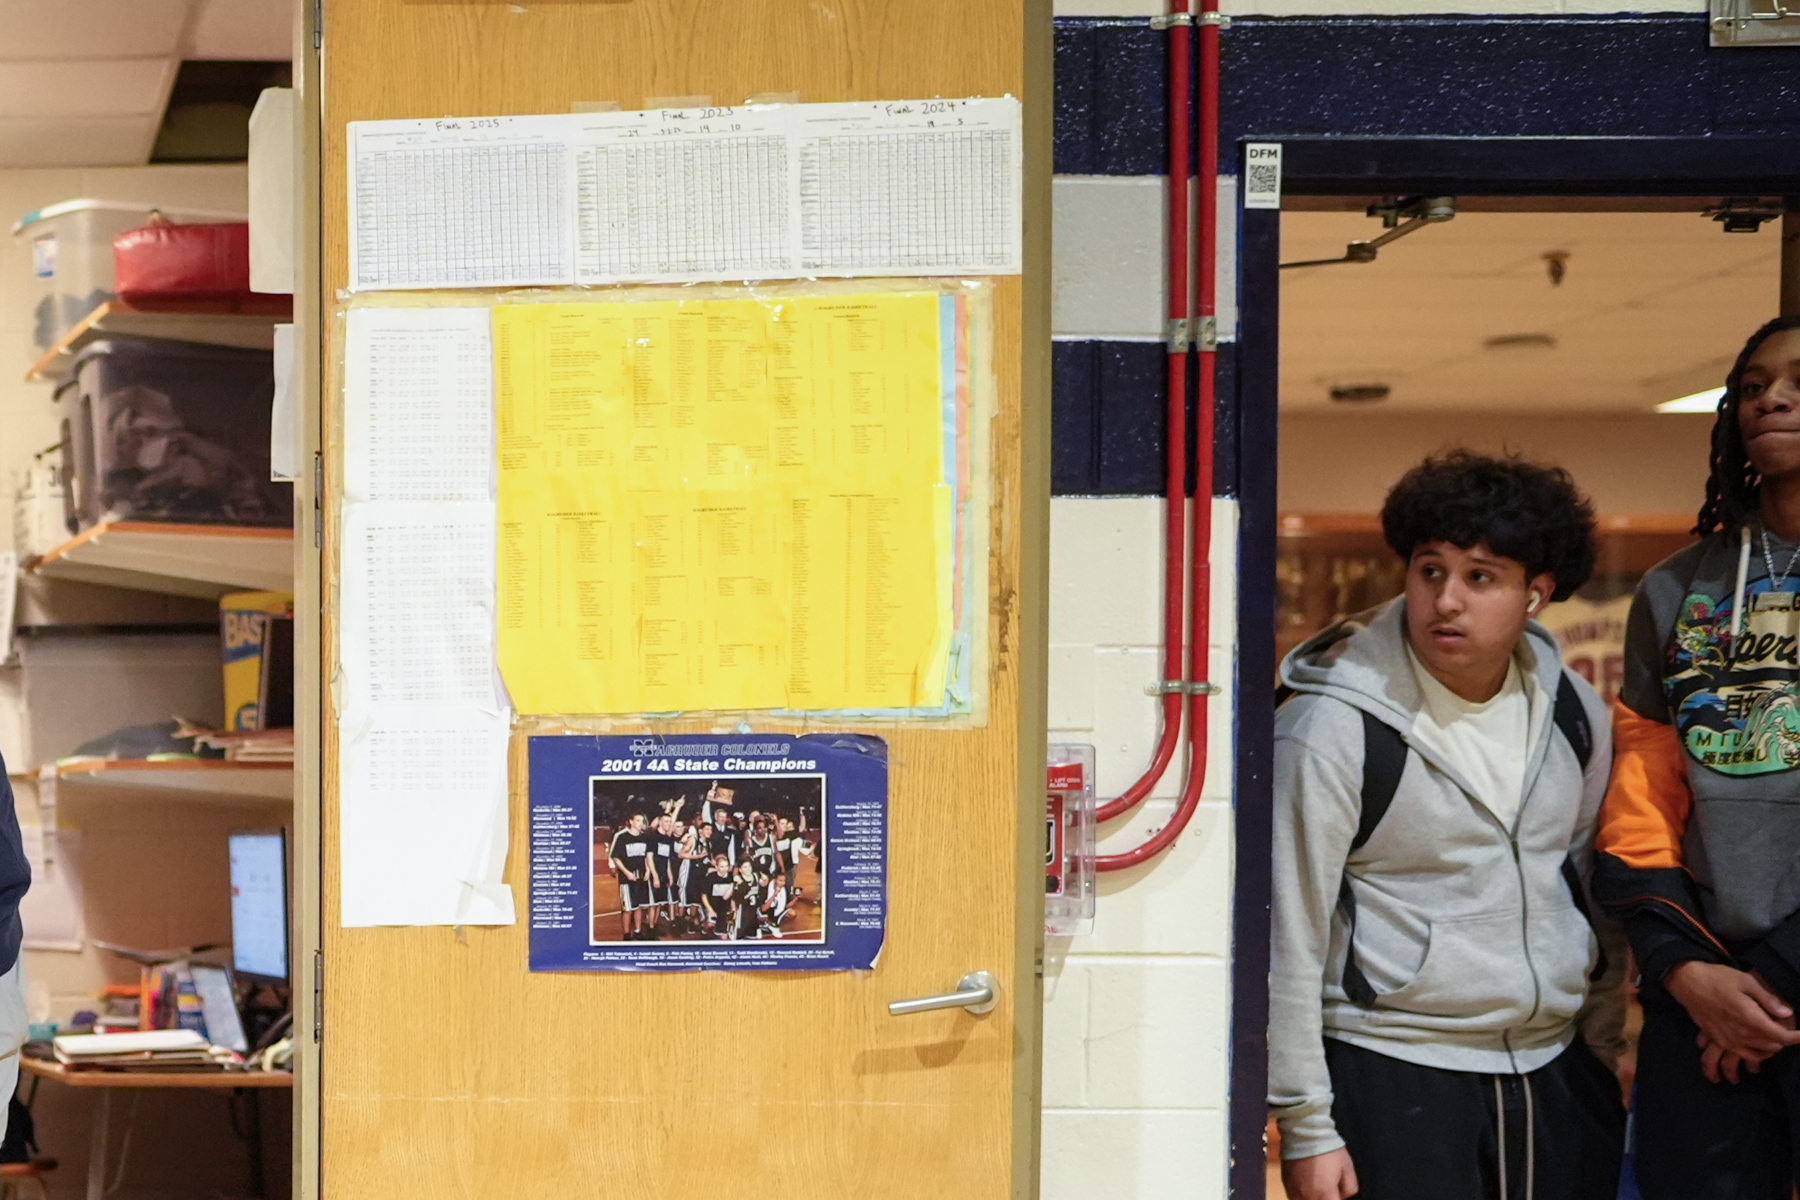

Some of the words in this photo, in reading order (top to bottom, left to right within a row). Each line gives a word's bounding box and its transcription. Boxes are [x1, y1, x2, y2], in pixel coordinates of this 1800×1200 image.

[700, 107, 733, 120] 2023
[921, 101, 955, 114] 2024
[470, 119, 500, 129] 2025
[699, 125, 710, 133] 14
[1250, 149, 1278, 158] DFM
[721, 743, 790, 756] COLONELS
[601, 759, 642, 773] 2001
[646, 758, 669, 772] 4A
[674, 758, 719, 772] State
[724, 757, 817, 773] Champions
